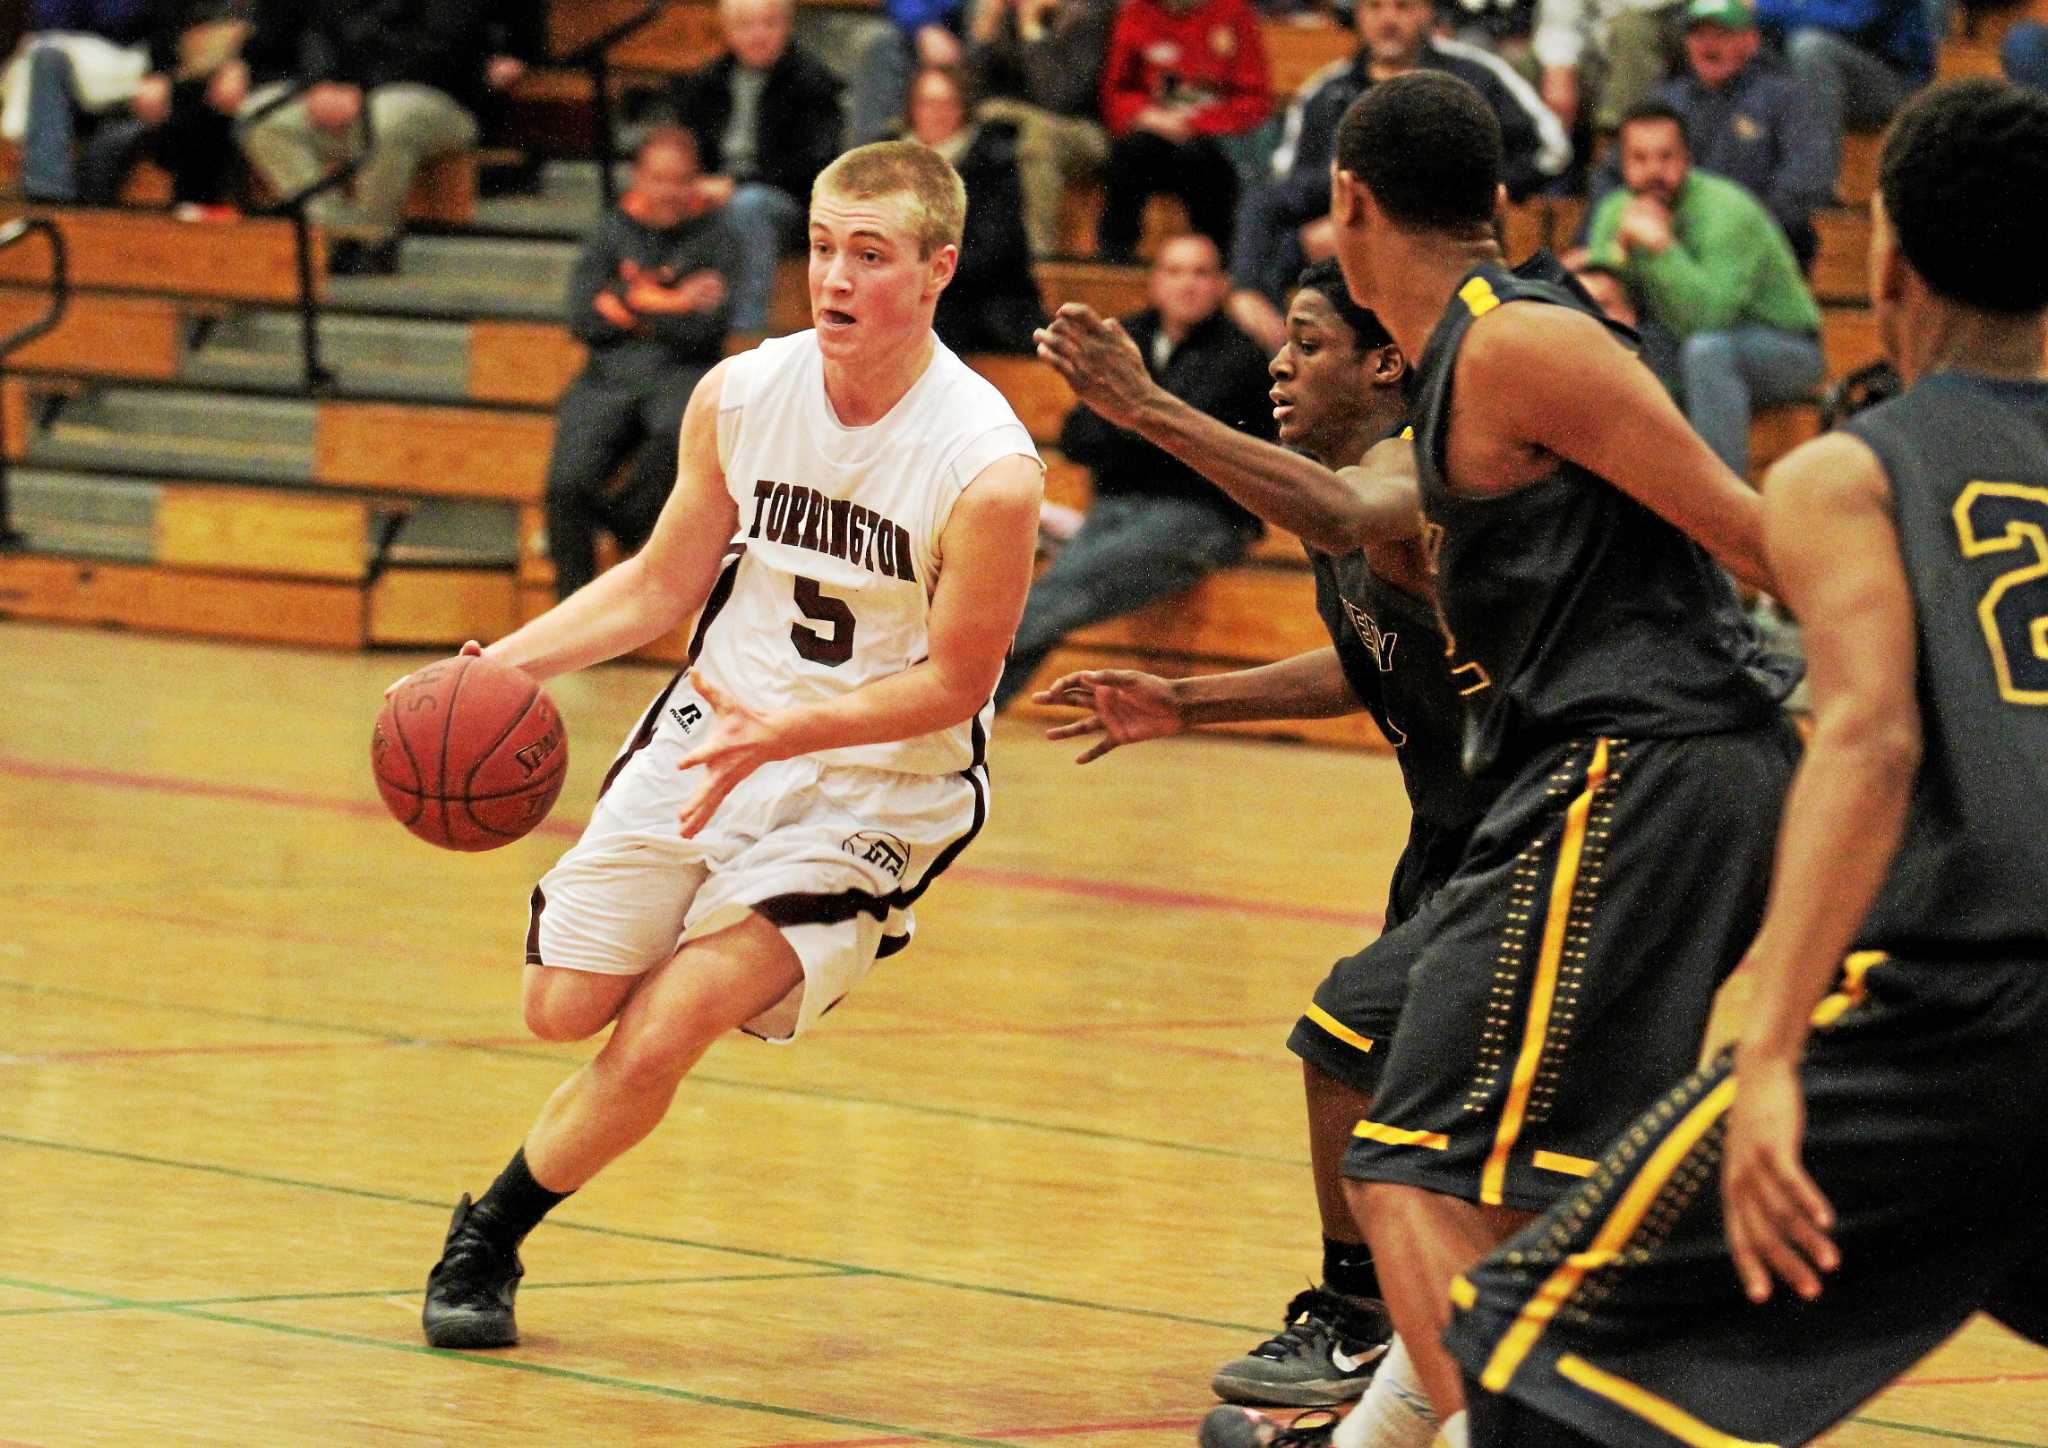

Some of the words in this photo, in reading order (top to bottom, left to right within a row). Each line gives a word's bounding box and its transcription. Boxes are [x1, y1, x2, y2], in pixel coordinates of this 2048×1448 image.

[748, 479, 917, 583] TORRINGTON
[790, 574, 856, 668] 5
[1952, 480, 2048, 704] 2
